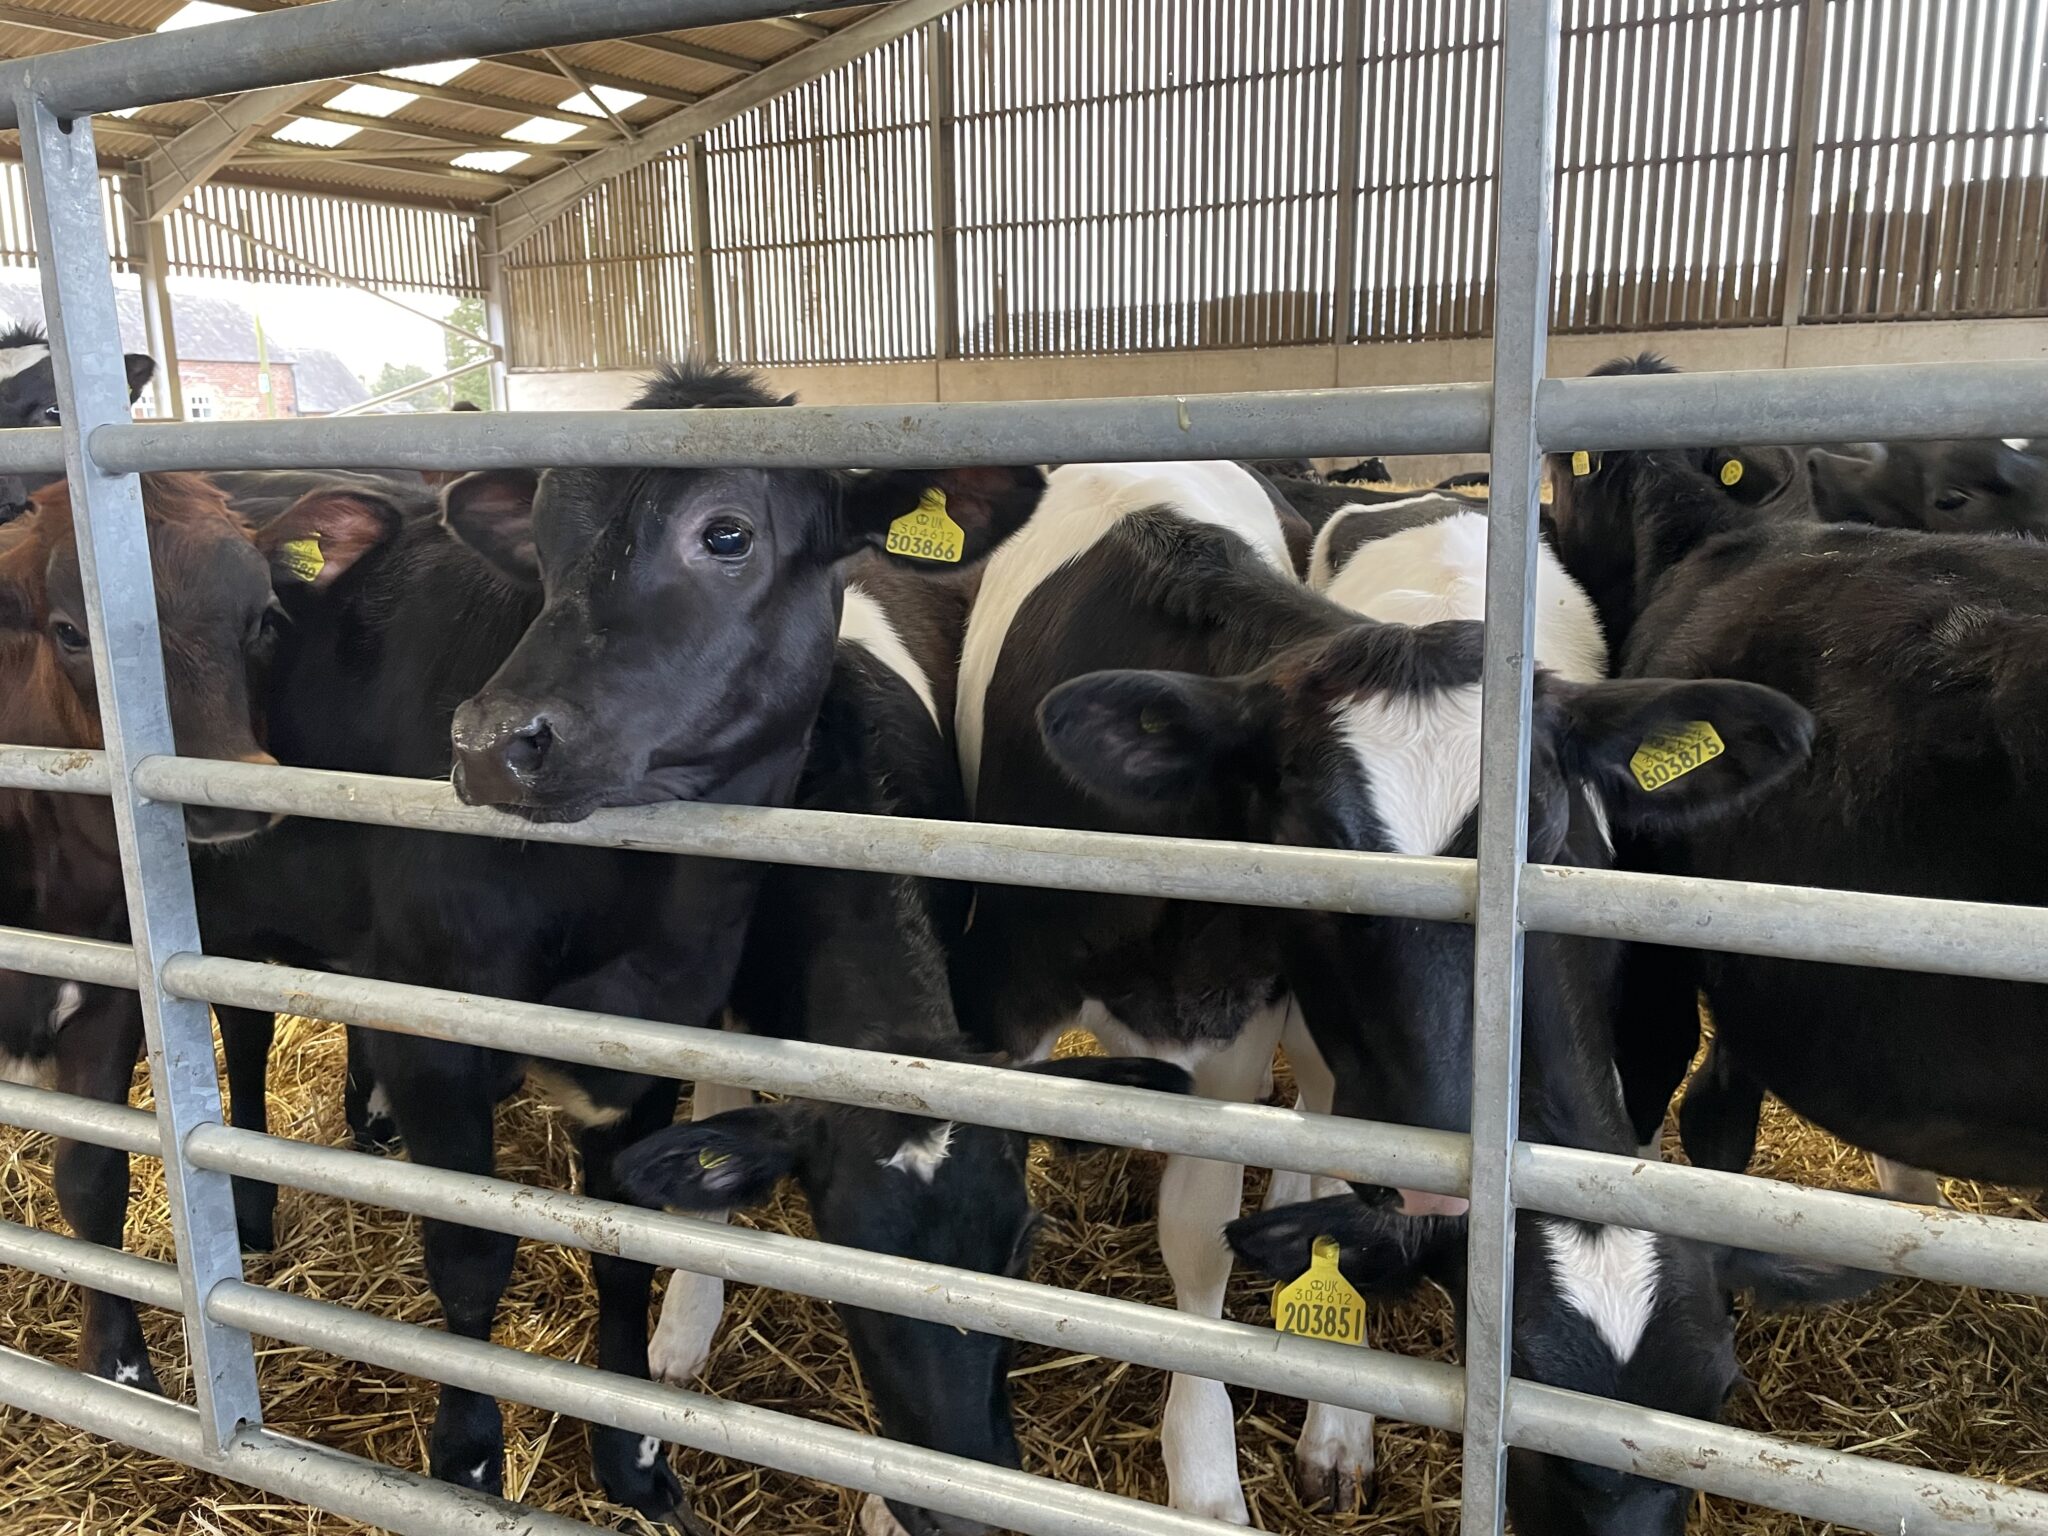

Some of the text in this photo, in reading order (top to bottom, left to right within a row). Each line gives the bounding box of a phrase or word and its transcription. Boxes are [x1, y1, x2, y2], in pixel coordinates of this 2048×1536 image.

[899, 523, 954, 542] 304612
[931, 516, 945, 530] UK
[887, 533, 955, 560] 303866
[1641, 735, 1721, 788] 503875
[1324, 1280, 1338, 1293] UK
[1294, 1288, 1352, 1306] 304612
[1284, 1301, 1361, 1341] 203851
